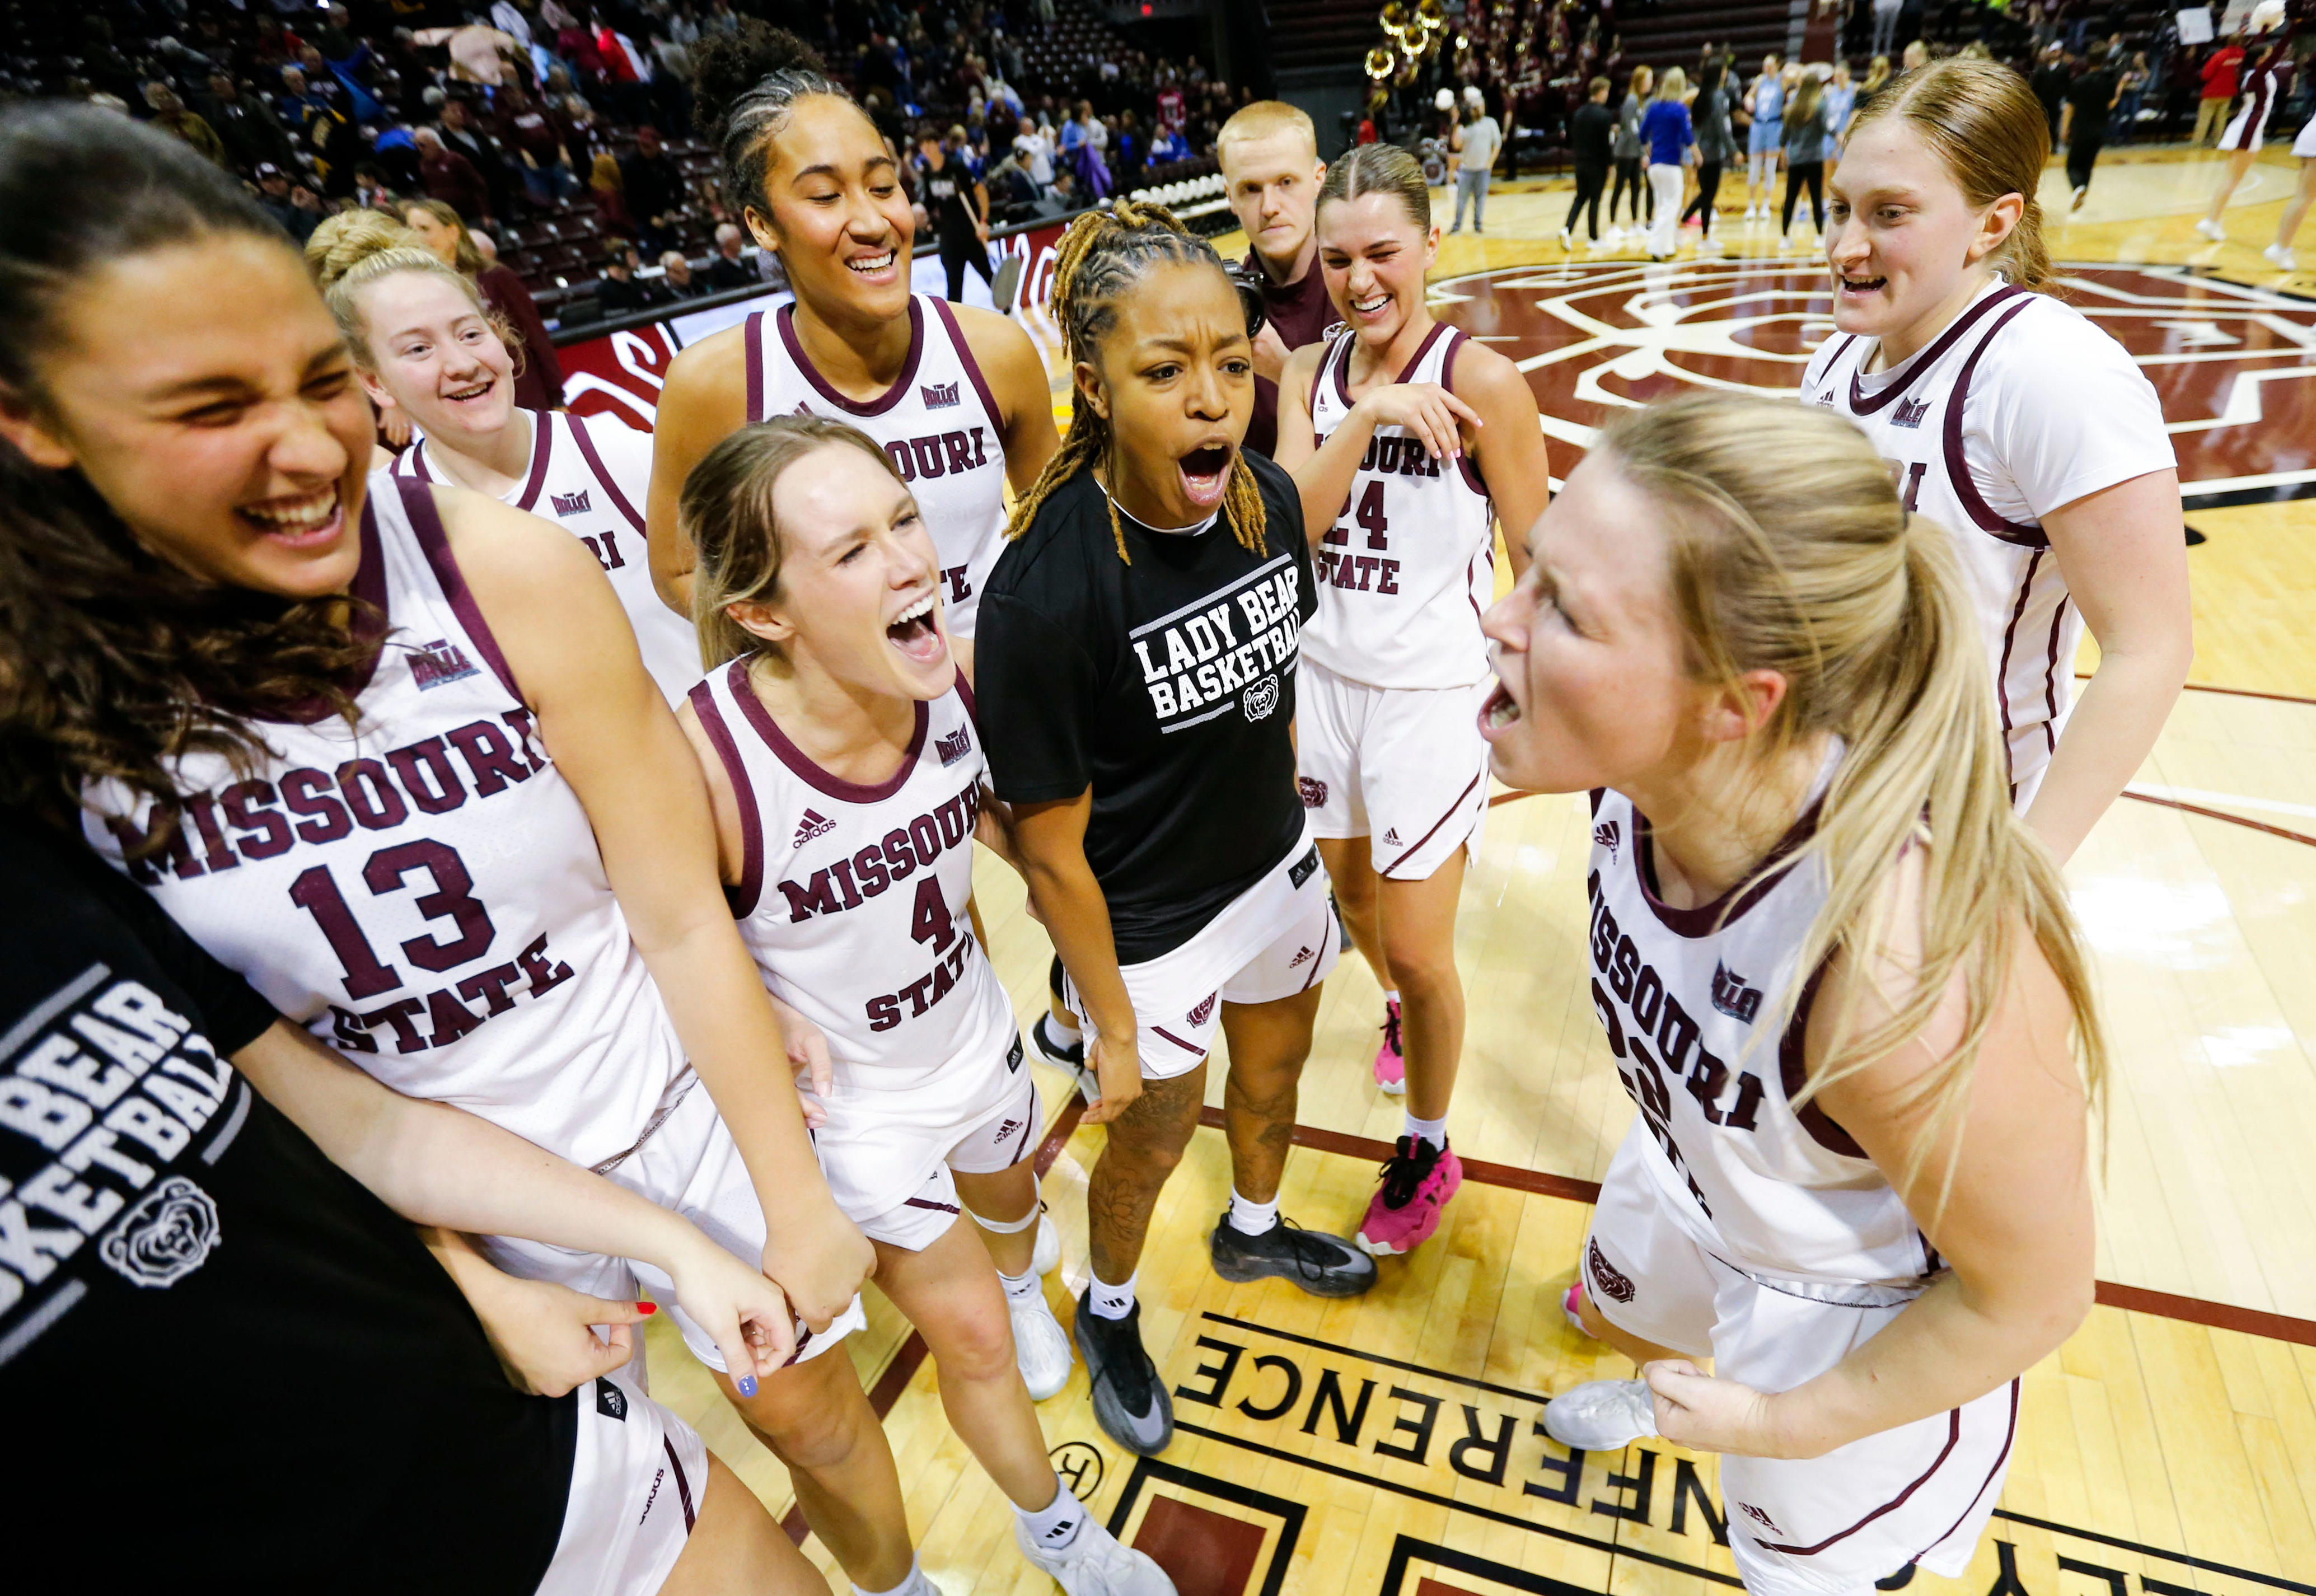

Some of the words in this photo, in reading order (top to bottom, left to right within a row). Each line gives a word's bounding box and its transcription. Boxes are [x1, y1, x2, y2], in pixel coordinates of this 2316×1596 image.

[884, 427, 987, 483] OURI
[1133, 602, 1238, 684] LADY
[1236, 565, 1299, 636] BEAR
[1149, 607, 1300, 720] BASKETBALL
[104, 706, 546, 886] MISSOURI
[792, 818, 836, 850] adidas
[288, 837, 496, 1000] 13
[911, 874, 956, 957] 4
[327, 932, 575, 1054] STATE
[0, 980, 191, 1152] BEAR
[0, 1033, 233, 1316] KETBALL
[1174, 1335, 1731, 1550] NFERENCE
